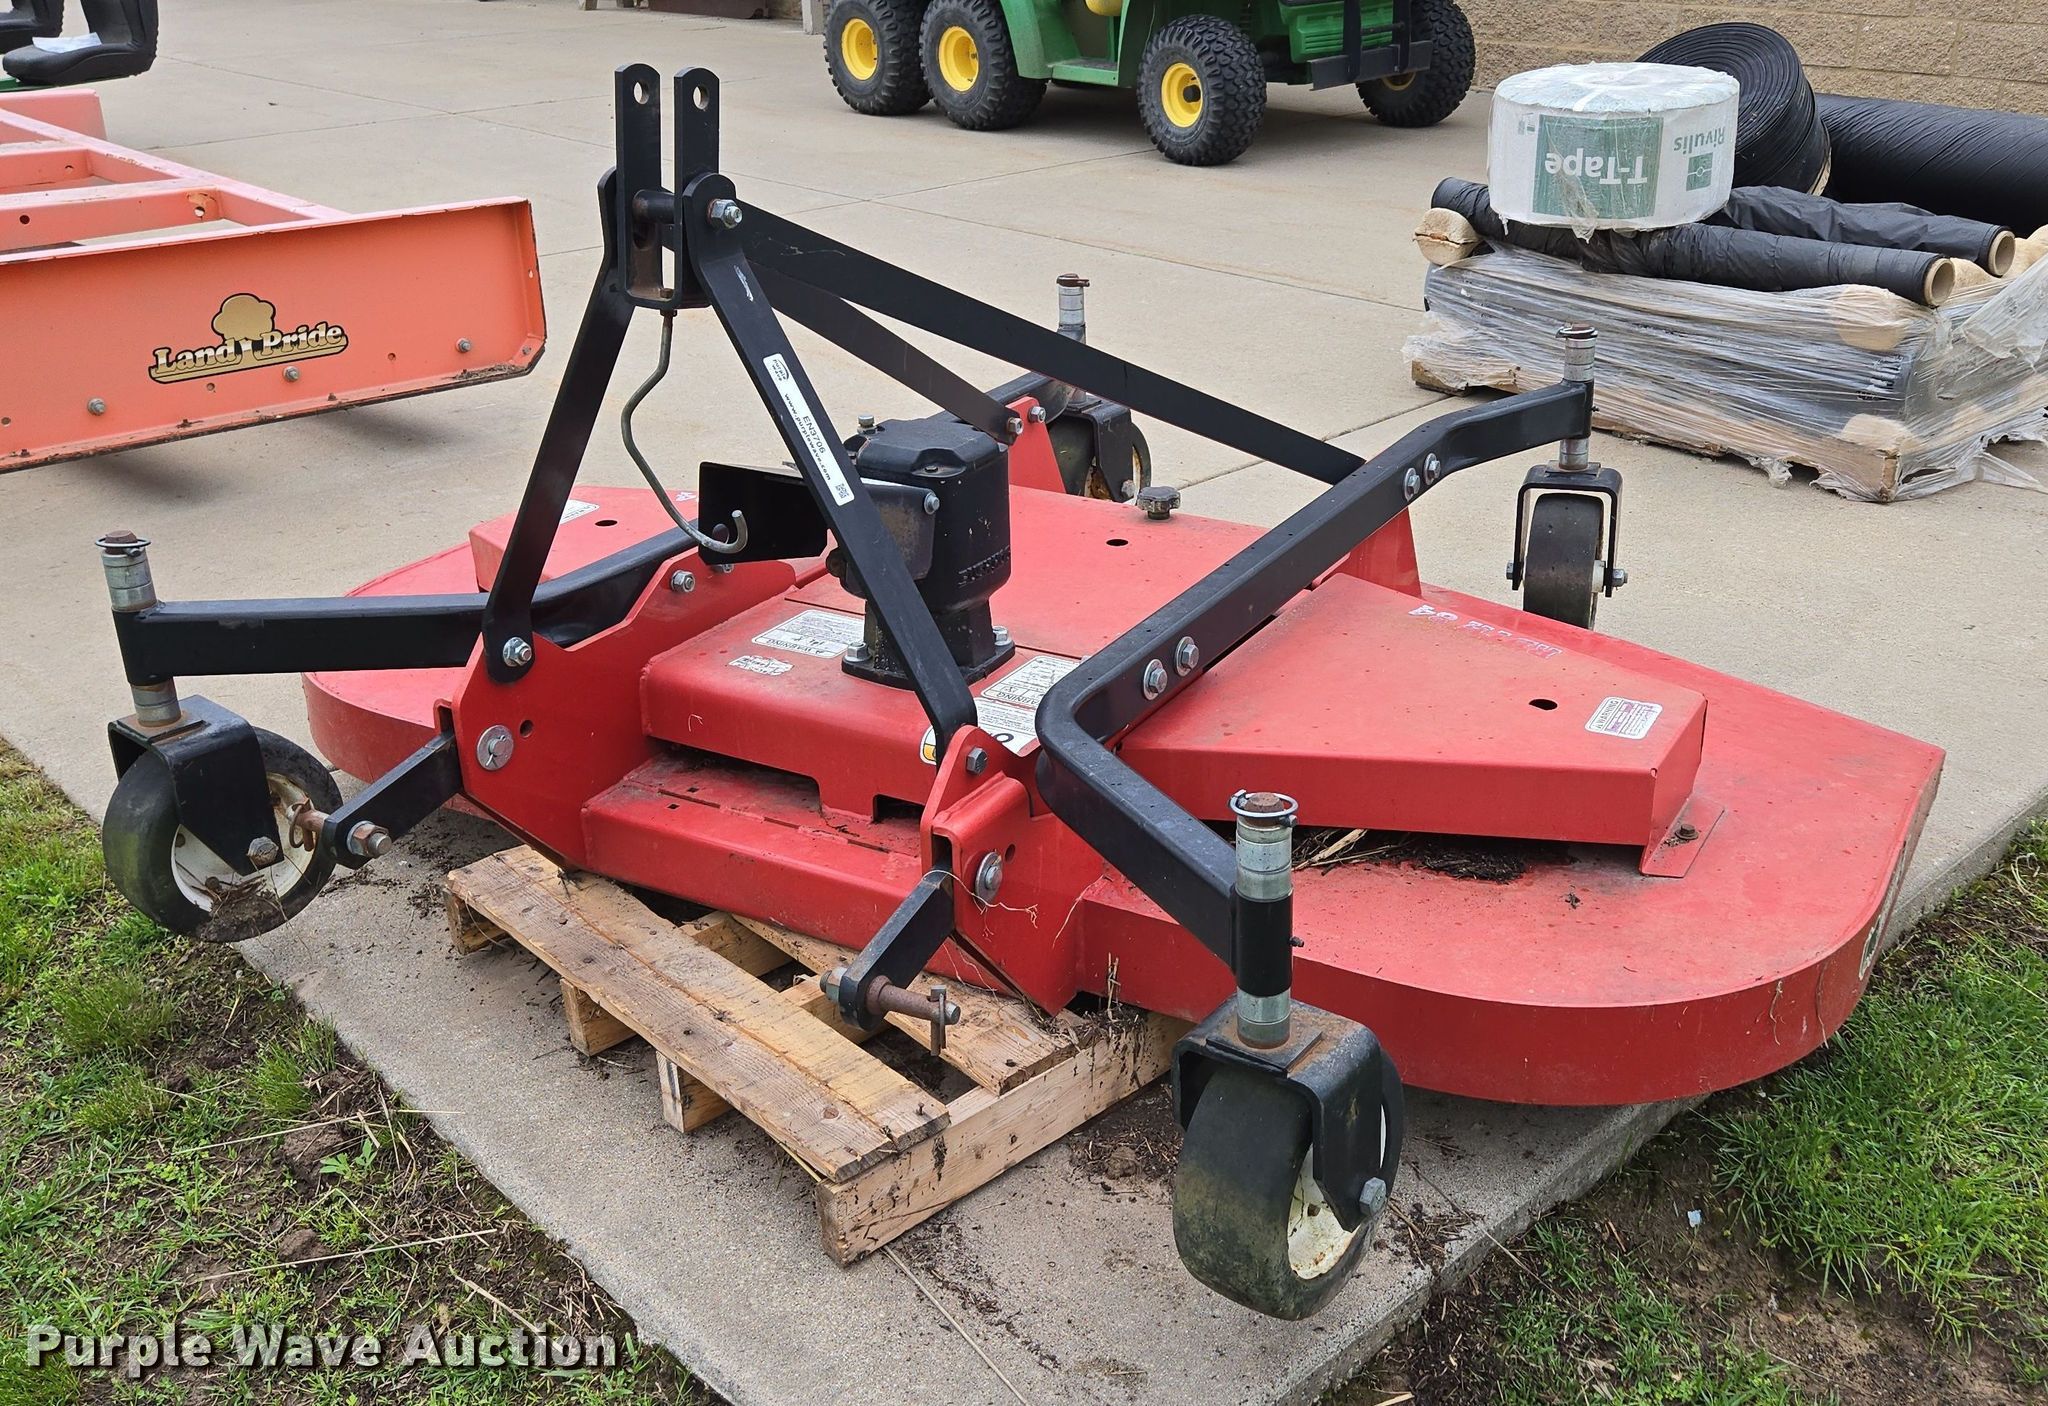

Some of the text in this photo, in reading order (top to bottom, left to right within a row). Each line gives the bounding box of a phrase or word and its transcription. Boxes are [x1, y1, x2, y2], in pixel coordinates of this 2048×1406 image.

[1673, 126, 1726, 155] Rivulis
[1544, 147, 1649, 186] T-Tape
[154, 321, 345, 375] Land Pride
[784, 392, 832, 482] www.purplewave.com
[802, 415, 827, 455] EN3706
[995, 691, 1039, 706] ARNING
